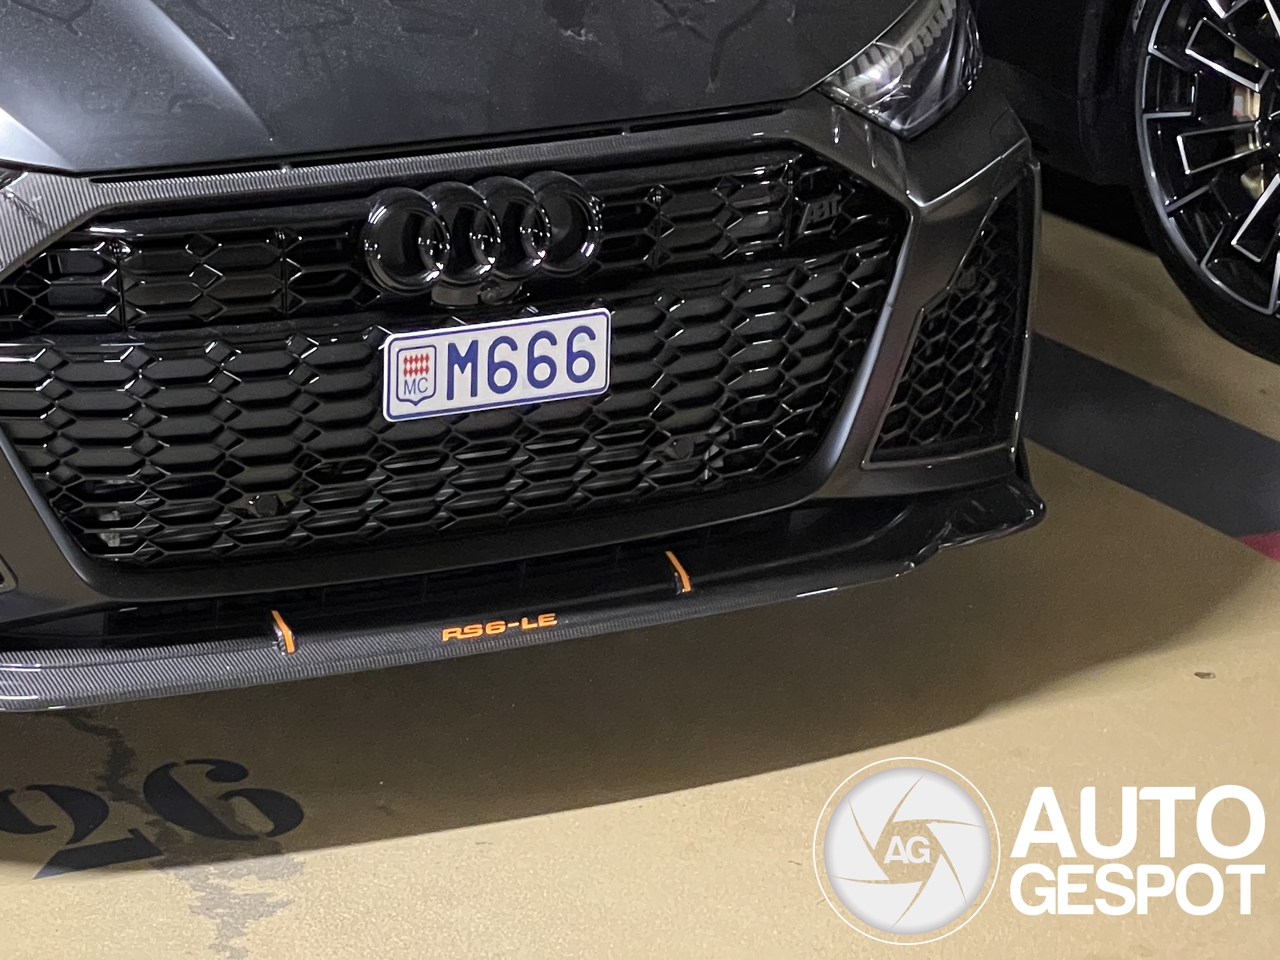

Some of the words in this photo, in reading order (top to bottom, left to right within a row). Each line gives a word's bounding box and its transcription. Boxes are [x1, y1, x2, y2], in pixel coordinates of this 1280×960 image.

[446, 325, 596, 401] M666
[403, 377, 429, 396] MC
[442, 613, 558, 642] RS6-LE
